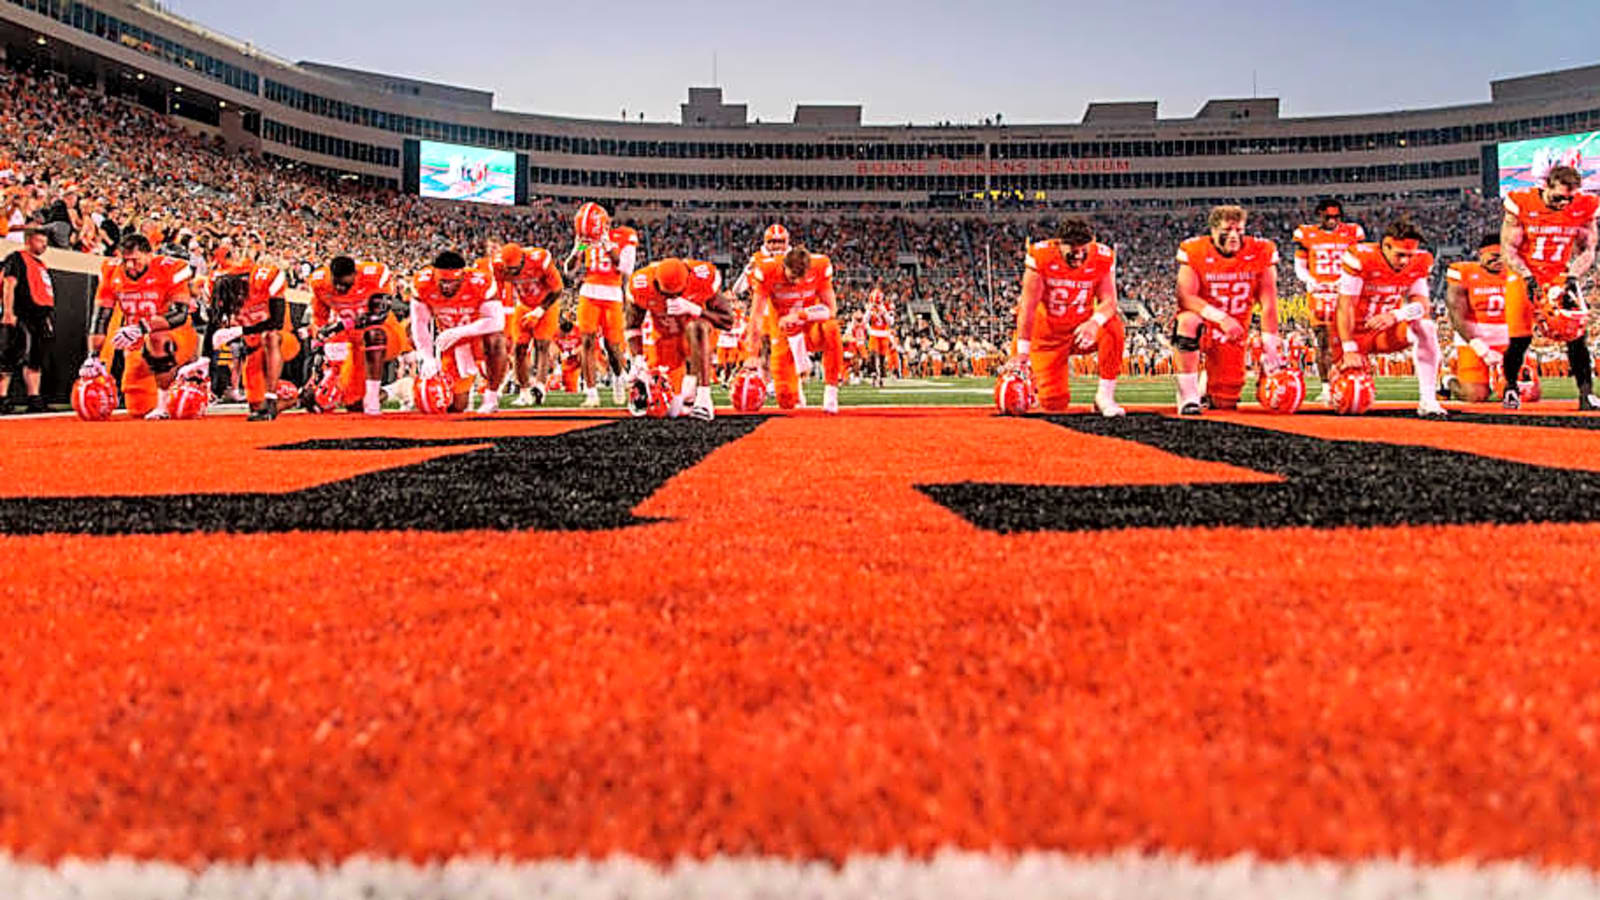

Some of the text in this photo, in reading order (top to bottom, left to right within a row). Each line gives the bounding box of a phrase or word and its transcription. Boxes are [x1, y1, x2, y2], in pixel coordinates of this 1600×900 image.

[856, 160, 1131, 176] BOONE PICKENS STADIUM
[589, 247, 612, 271] 15
[1532, 236, 1570, 261] 17
[1049, 288, 1088, 316] 64
[1210, 282, 1250, 314] 52
